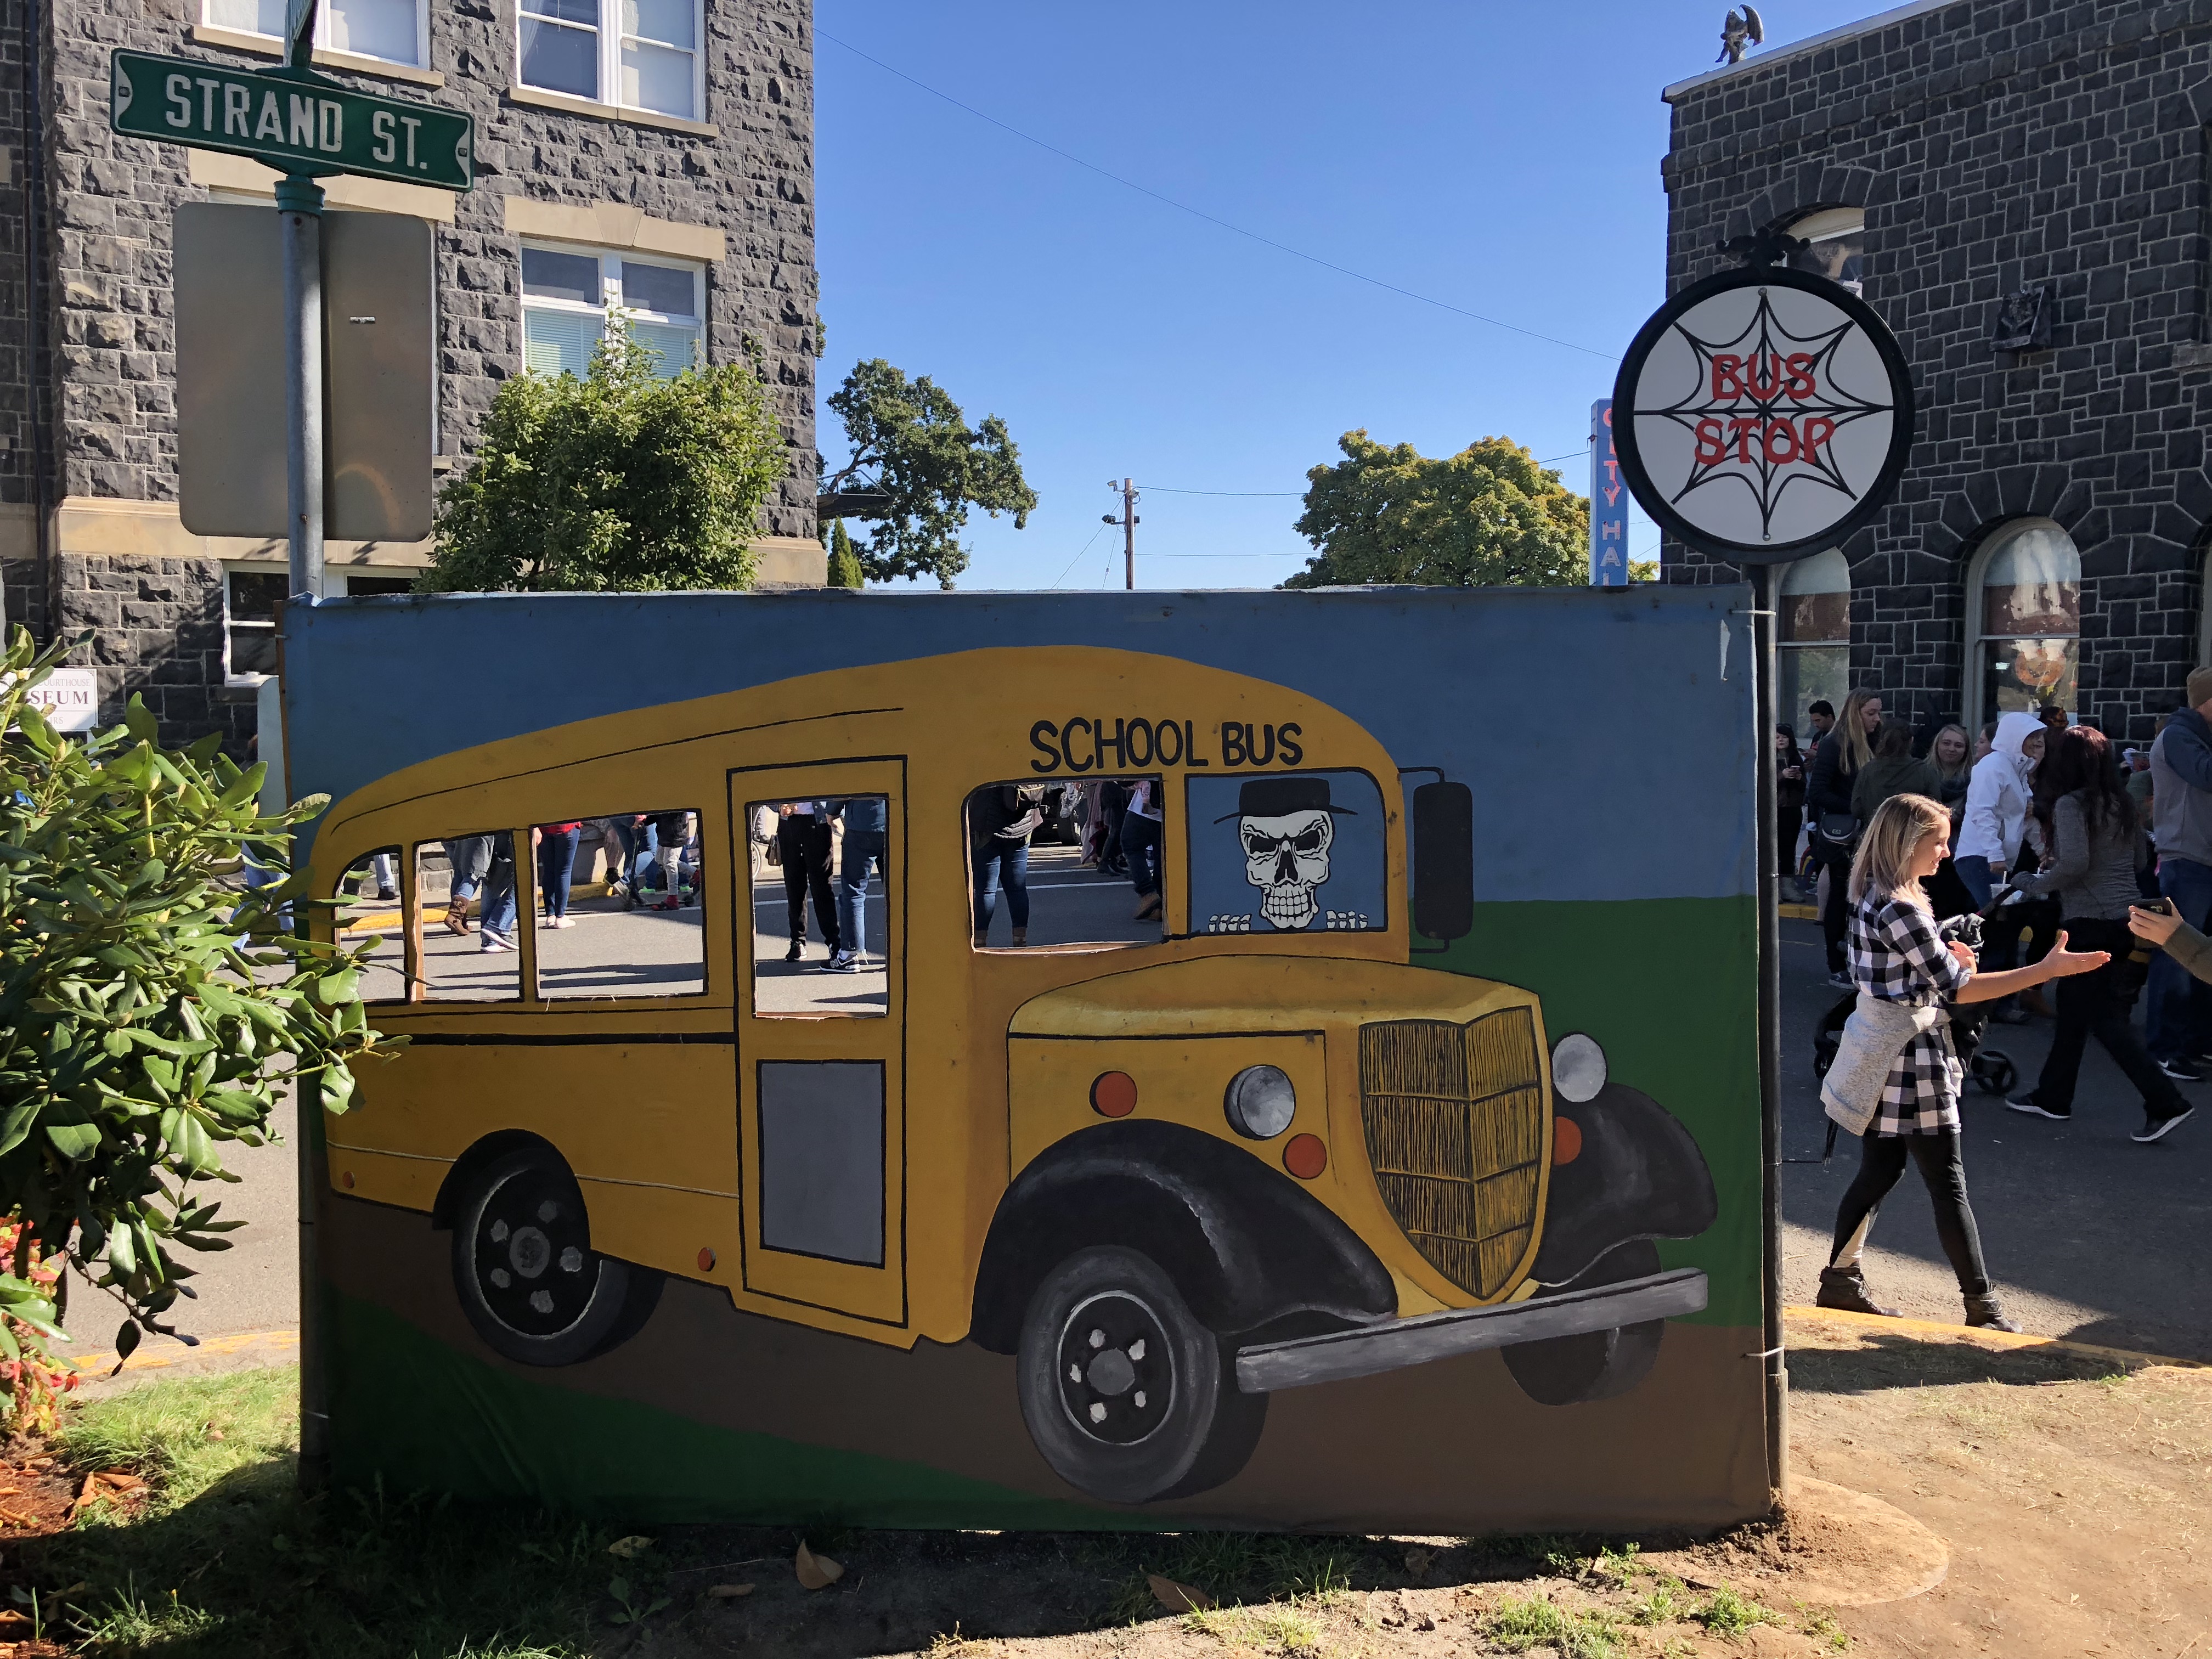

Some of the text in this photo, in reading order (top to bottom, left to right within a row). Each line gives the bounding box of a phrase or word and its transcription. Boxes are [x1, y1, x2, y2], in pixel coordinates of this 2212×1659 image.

[166, 74, 428, 170] STRAND ST.
[1712, 352, 1816, 400] BUS
[1694, 417, 1836, 465] STOP
[1029, 716, 1304, 773] SCHOOL BUS
